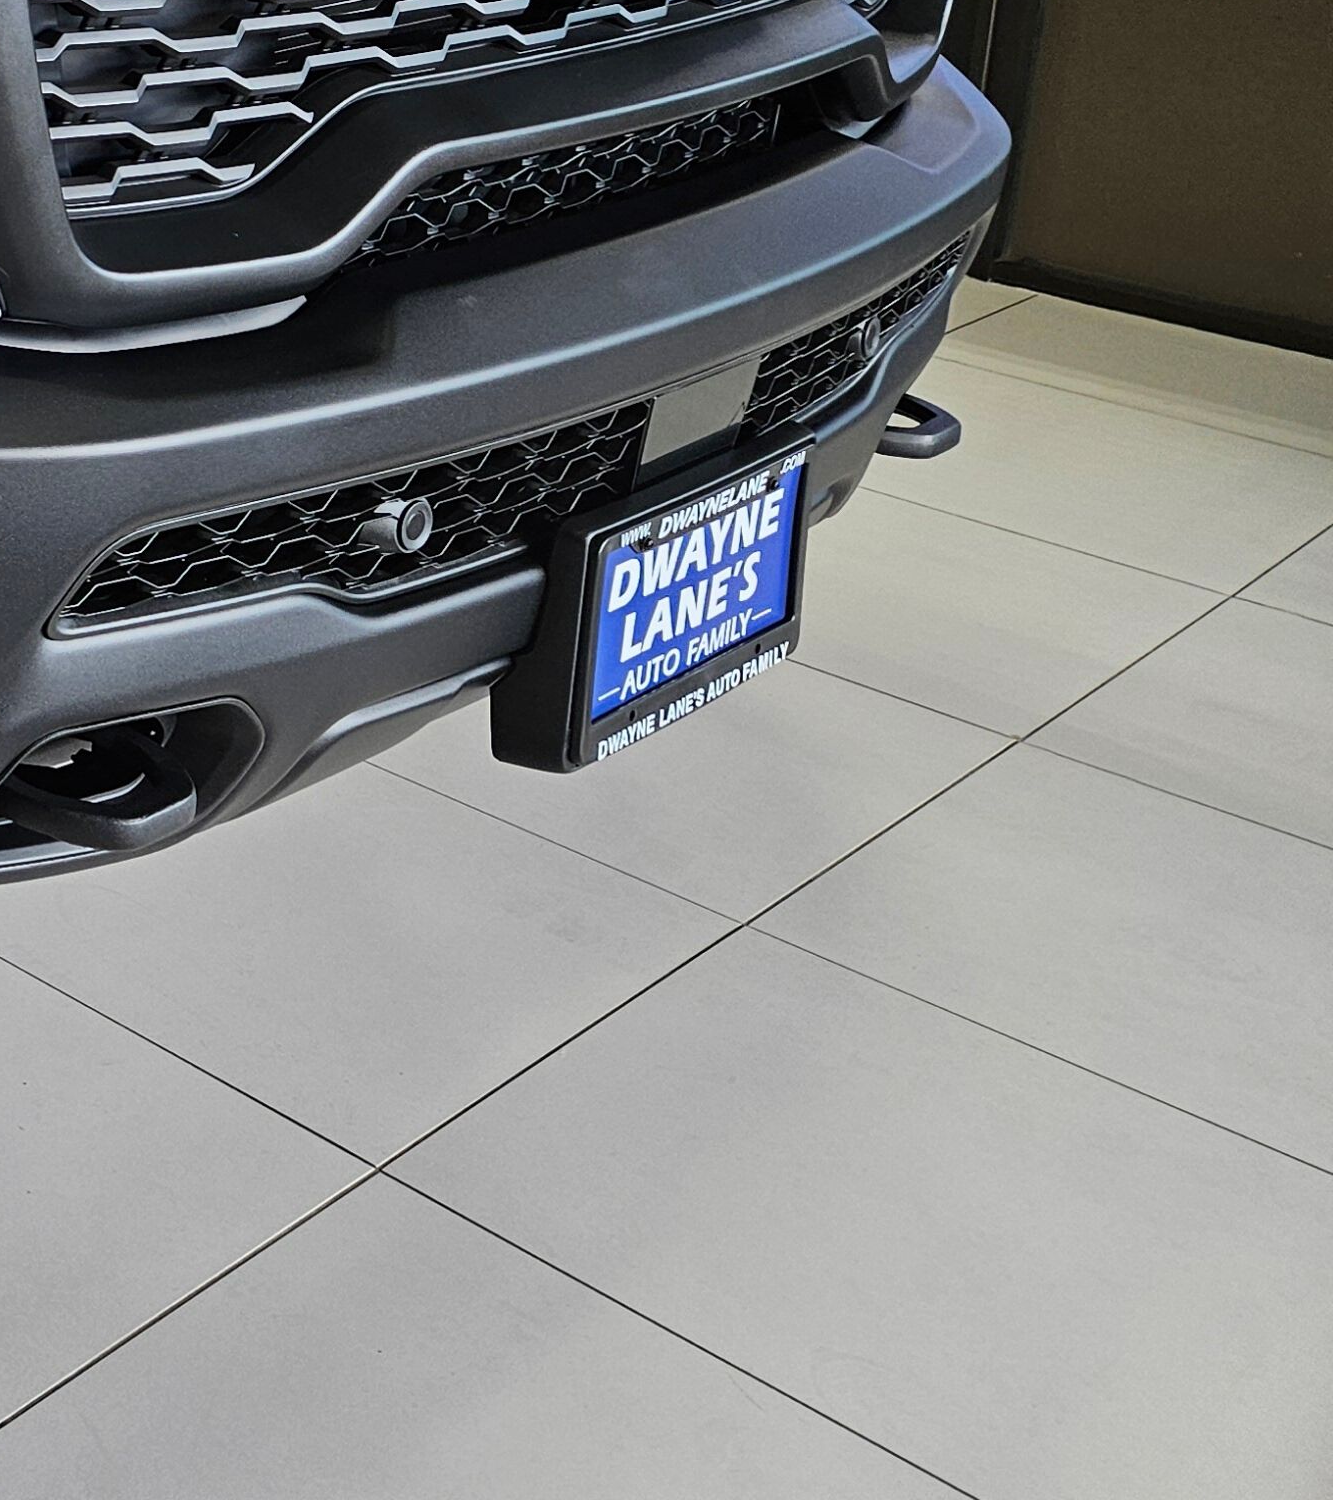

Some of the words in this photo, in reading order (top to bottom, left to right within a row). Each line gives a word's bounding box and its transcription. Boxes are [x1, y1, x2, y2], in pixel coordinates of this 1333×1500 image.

[607, 488, 785, 613] DWAYNE
[658, 470, 771, 539] DWAYNELANE
[780, 451, 807, 475] .COM
[620, 551, 761, 663] LANE'S
[620, 646, 681, 701] AUTO
[686, 607, 753, 667] FAMILY
[597, 713, 656, 762] DWAYNE
[658, 687, 705, 728] LANE'S
[706, 670, 741, 702] AUTO
[742, 641, 790, 683] FAMILY
